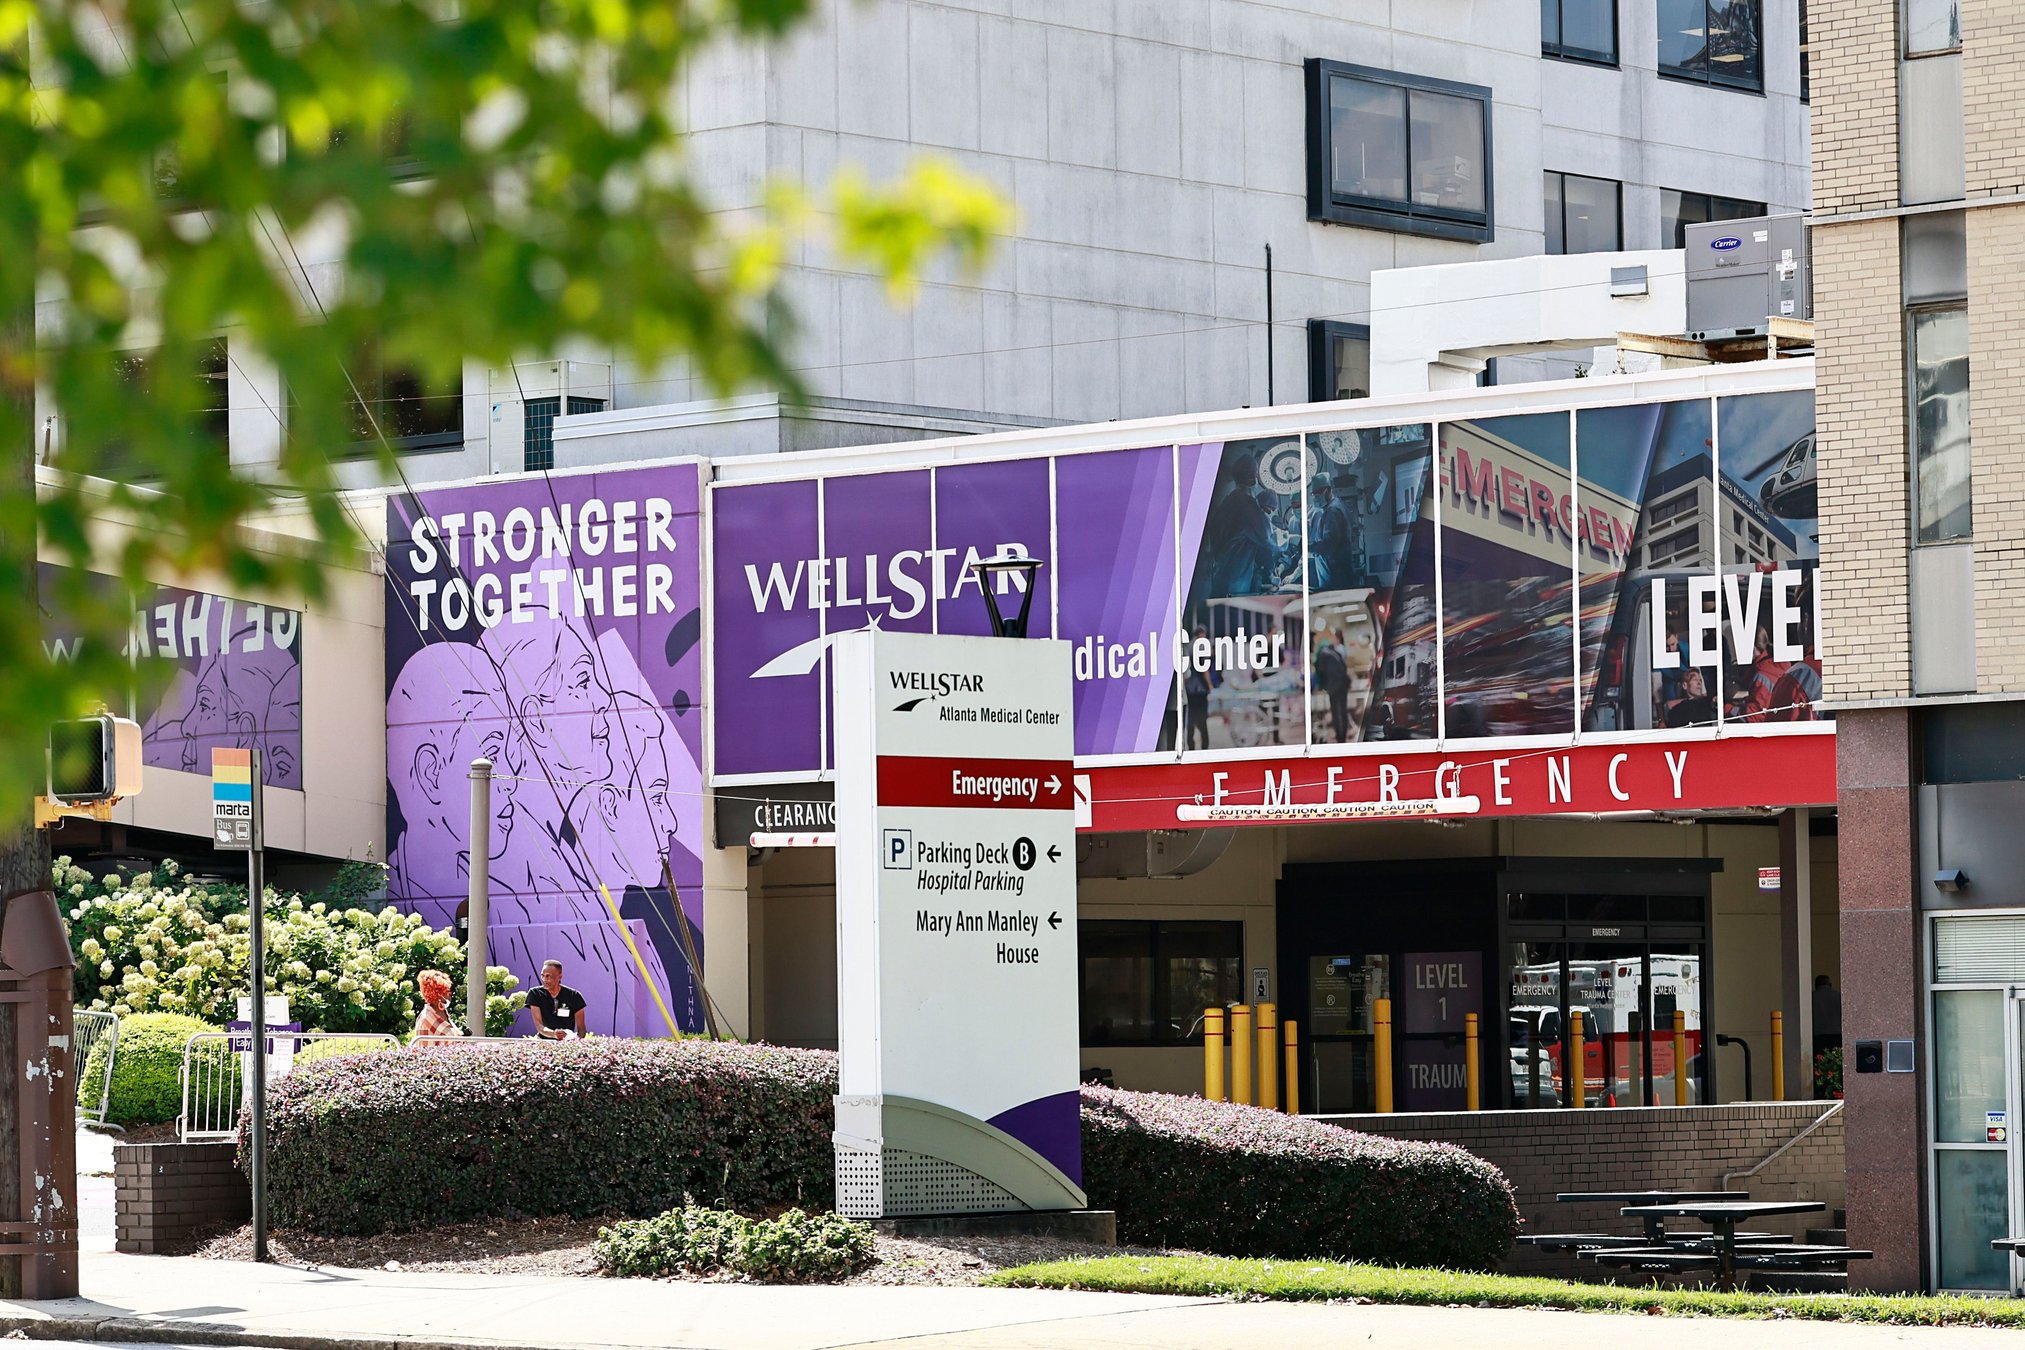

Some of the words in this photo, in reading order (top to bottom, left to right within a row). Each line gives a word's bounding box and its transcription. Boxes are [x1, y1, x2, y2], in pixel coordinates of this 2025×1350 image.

[1715, 240, 1738, 248] Carrier
[1733, 486, 1754, 511] Medical
[1754, 504, 1769, 524] Center
[409, 498, 677, 574] STRONGER
[410, 564, 676, 631] TOGETHER
[1075, 631, 1158, 681] dical
[1173, 627, 1285, 674] Center
[890, 671, 984, 697] WELLSTAR
[939, 706, 977, 722] Atlanta
[980, 707, 1022, 724] Medical
[1026, 709, 1060, 725] Center
[952, 770, 1038, 803] Emergency
[216, 803, 250, 816] marta
[754, 802, 836, 828] CLEARANC
[1266, 807, 1318, 815] CAUTION
[1323, 805, 1375, 813] CAUTION
[1381, 803, 1434, 811] CAUTION
[216, 819, 232, 830] Bus
[891, 838, 905, 862] P
[917, 841, 971, 869] Parking
[976, 842, 1009, 864] Deck
[917, 870, 972, 895] Hospital
[974, 870, 1025, 896] Parking
[916, 910, 952, 937] Mary
[956, 910, 983, 931] Ann
[988, 910, 1039, 937] Manley
[1592, 928, 1620, 937] EMERGENCY
[996, 942, 1039, 963] House
[1416, 964, 1468, 989] LEVEL
[1593, 978, 1613, 987] LEVEL
[1512, 985, 1557, 996] EMERGENCY
[1580, 990, 1606, 1000] TRAUMA
[1607, 990, 1631, 1000] CENTER
[1654, 985, 1696, 996] EMERGENCY
[1438, 997, 1447, 1021] 1
[1409, 1064, 1468, 1089] TRAUM
